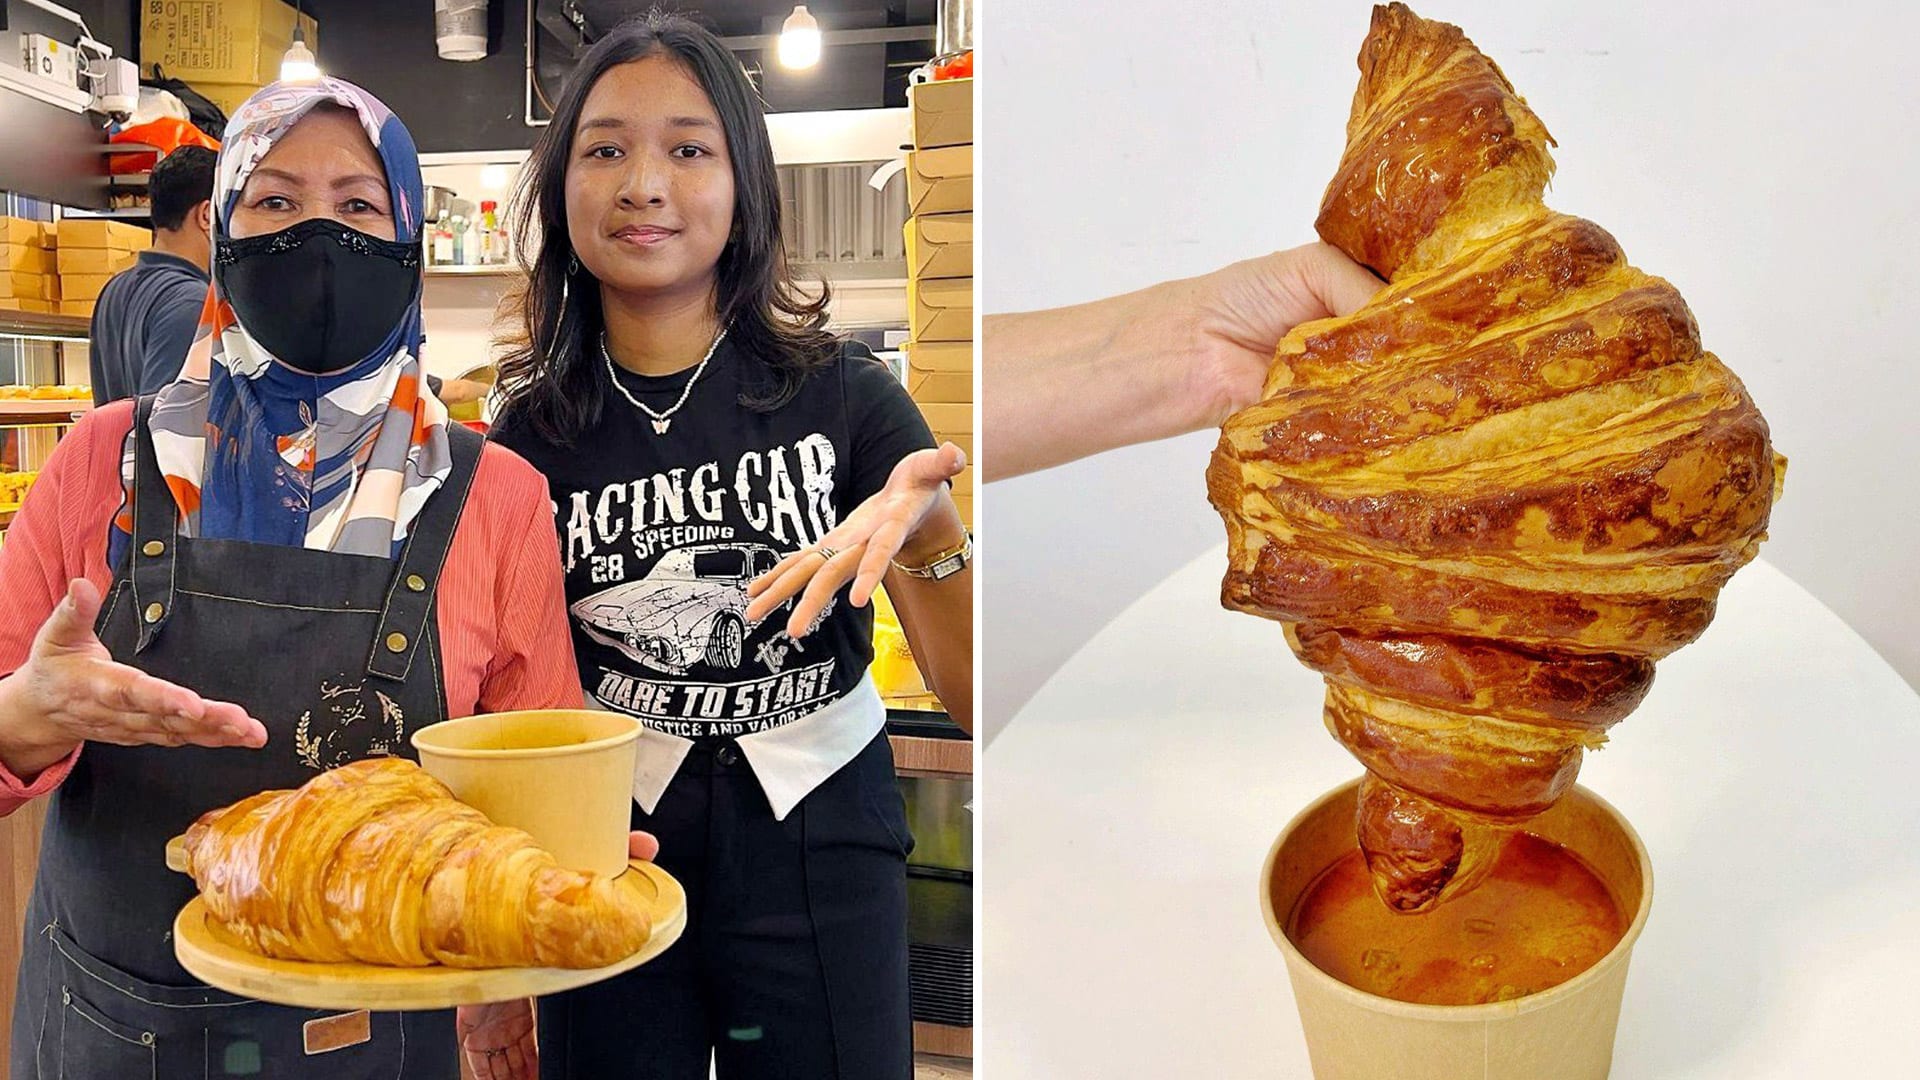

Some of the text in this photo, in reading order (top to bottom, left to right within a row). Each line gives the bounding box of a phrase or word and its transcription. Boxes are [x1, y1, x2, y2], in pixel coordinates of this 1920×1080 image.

[552, 433, 836, 574] ACING CAR
[631, 525, 735, 560] SPEEDING
[591, 554, 625, 583] 28
[597, 661, 836, 718] DARE TO START
[709, 723, 743, 736] AND
[748, 710, 796, 732] VALOR
